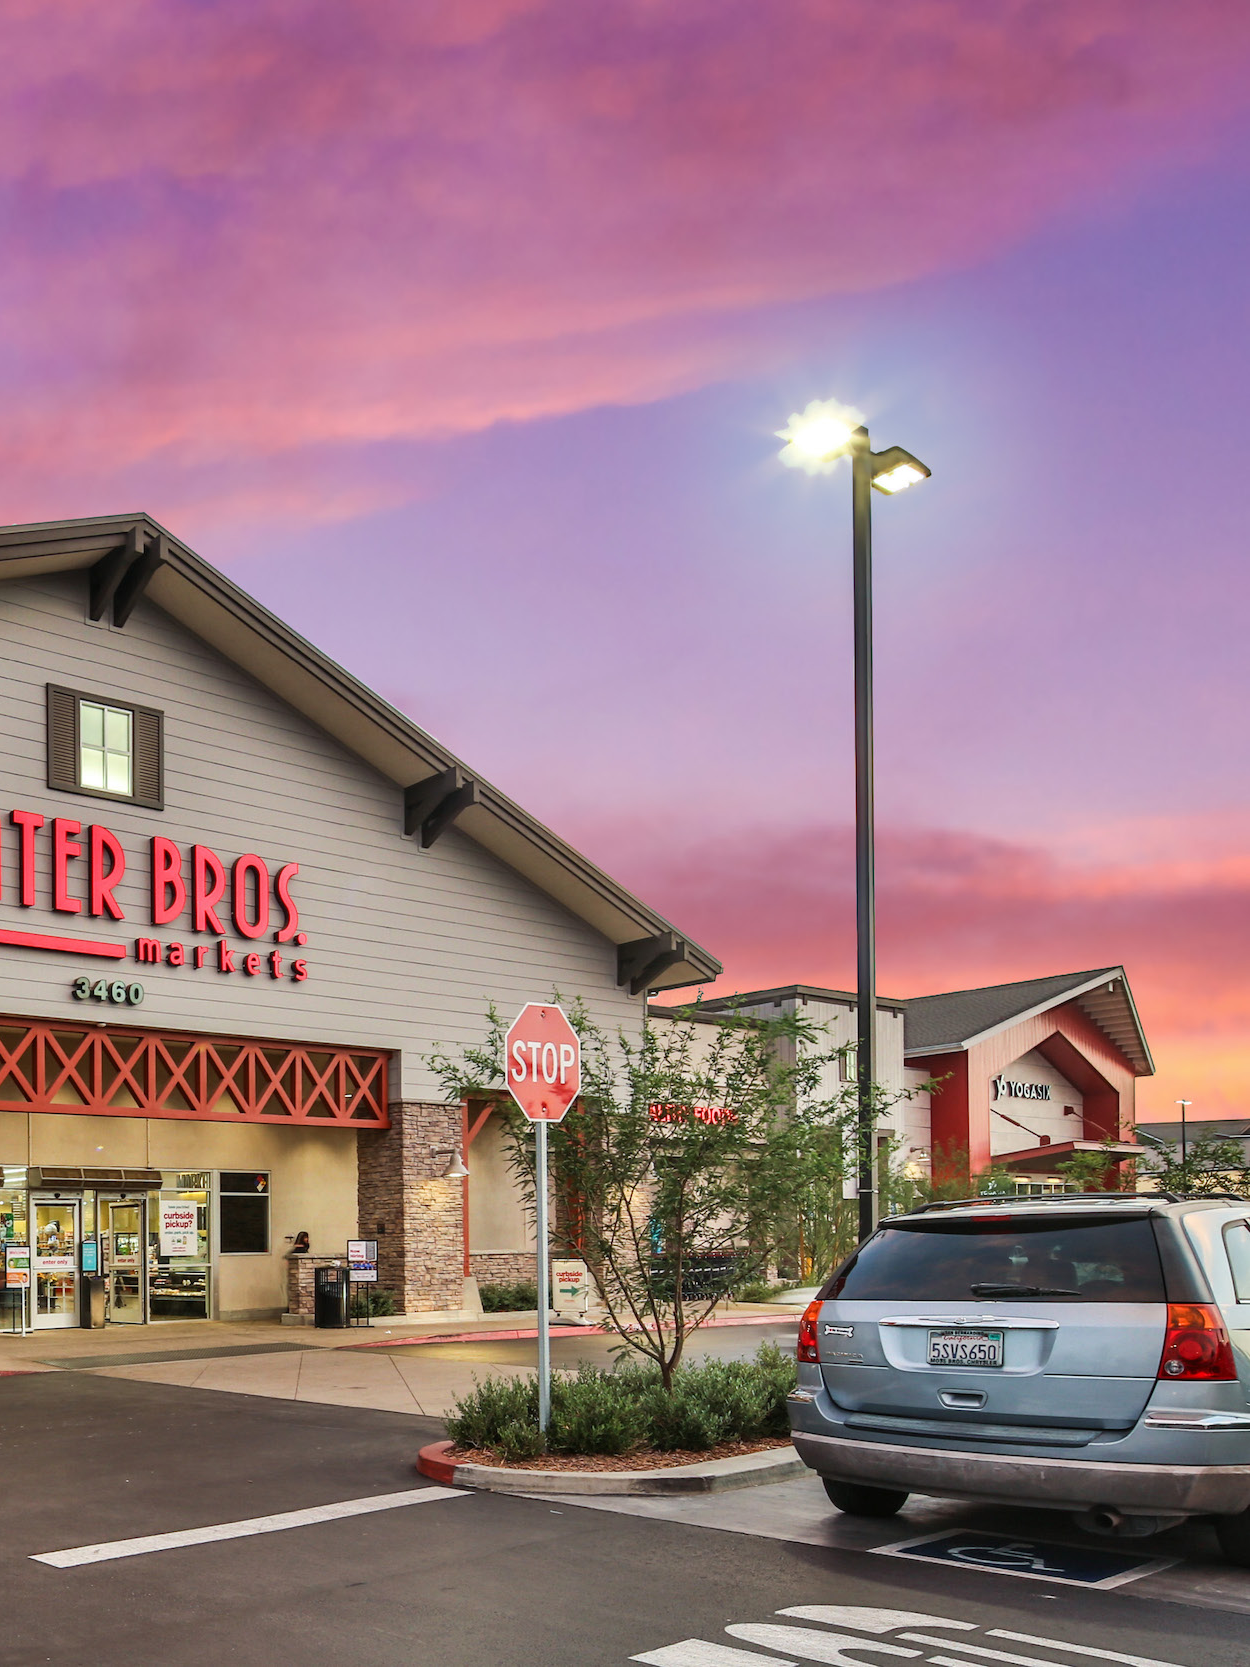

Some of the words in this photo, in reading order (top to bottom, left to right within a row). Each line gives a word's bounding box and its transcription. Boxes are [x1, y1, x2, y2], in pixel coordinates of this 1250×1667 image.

[150, 836, 308, 947] BROS.
[135, 936, 308, 982] markets
[72, 976, 144, 1006] 3460
[511, 1039, 575, 1084] STOP
[1010, 1081, 1051, 1100] YOGASIX
[163, 1211, 194, 1220] curbside
[165, 1219, 193, 1229] pickup?
[558, 1276, 580, 1284] pickup
[943, 1335, 984, 1343] California
[932, 1343, 996, 1360] 5SVS650
